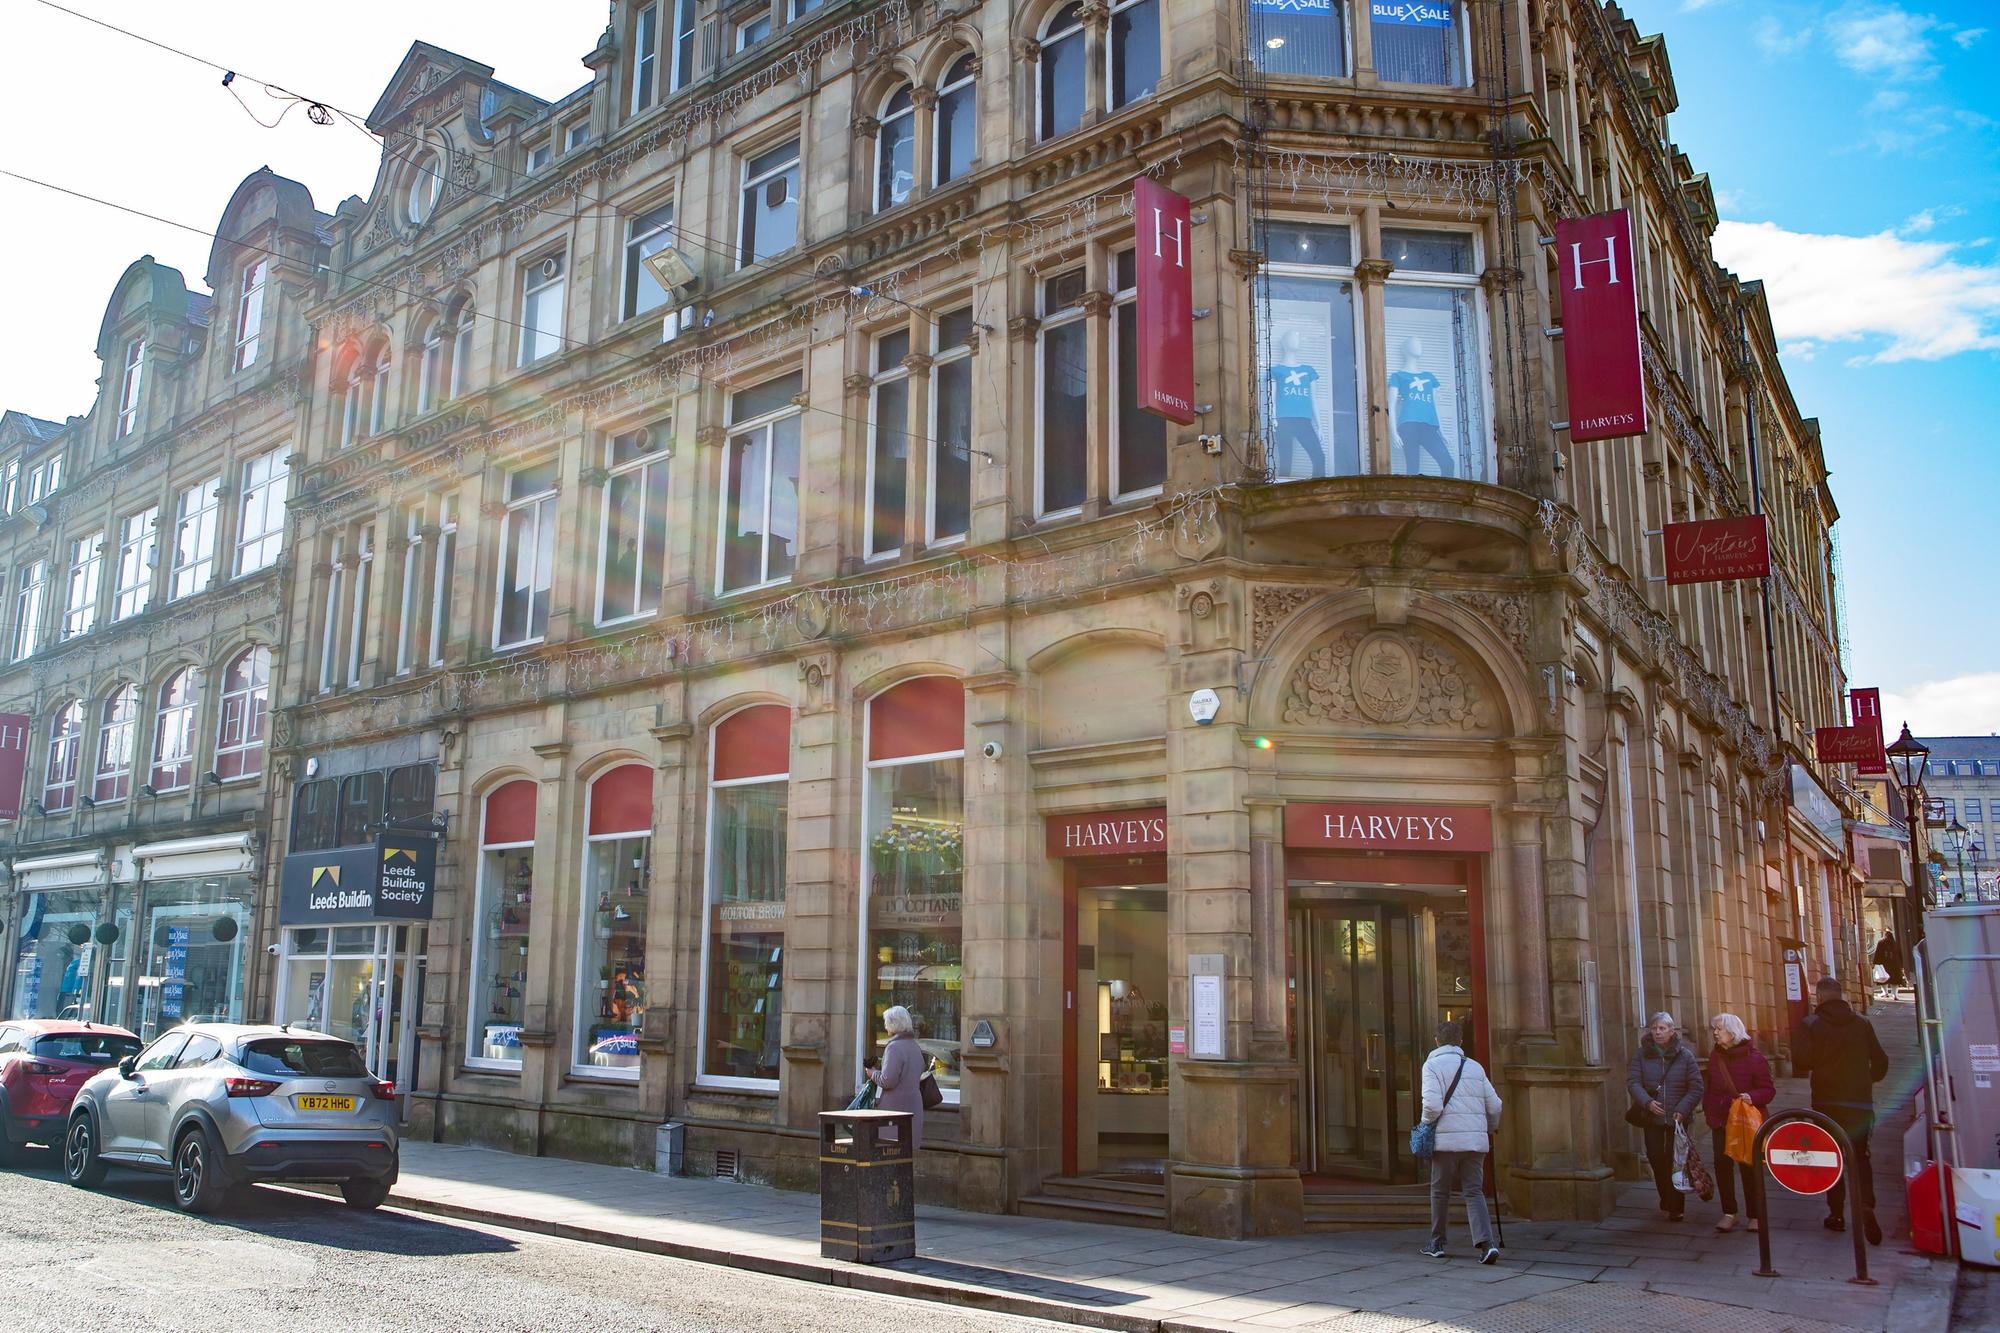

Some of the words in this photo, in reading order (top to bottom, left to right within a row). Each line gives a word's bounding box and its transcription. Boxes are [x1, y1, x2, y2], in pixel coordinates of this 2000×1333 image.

[1300, 0, 1330, 9] SALE
[1373, 4, 1403, 17] BLUE
[1420, 8, 1450, 21] SALE
[1153, 207, 1184, 268] H
[1570, 236, 1621, 290] H
[1283, 386, 1309, 397] SALE
[1154, 390, 1189, 411] HARVEYS
[1580, 414, 1634, 430] HARVEYS
[1675, 526, 1757, 566] Upstairs
[1673, 563, 1764, 579] RESTAURANT
[1856, 697, 1877, 718] H
[0, 725, 23, 750] H
[1065, 818, 1165, 848] HARVEYS
[1323, 814, 1455, 841] HARVEYS
[383, 863, 416, 877] Leeds
[382, 876, 426, 892] Building
[309, 892, 338, 910] Leeds
[338, 889, 372, 909] Buildin
[381, 888, 423, 904] Society
[720, 906, 756, 921] MOLTON
[302, 1097, 328, 1108] YB72
[331, 1098, 350, 1109] HHG
[830, 1145, 848, 1154] Litter
